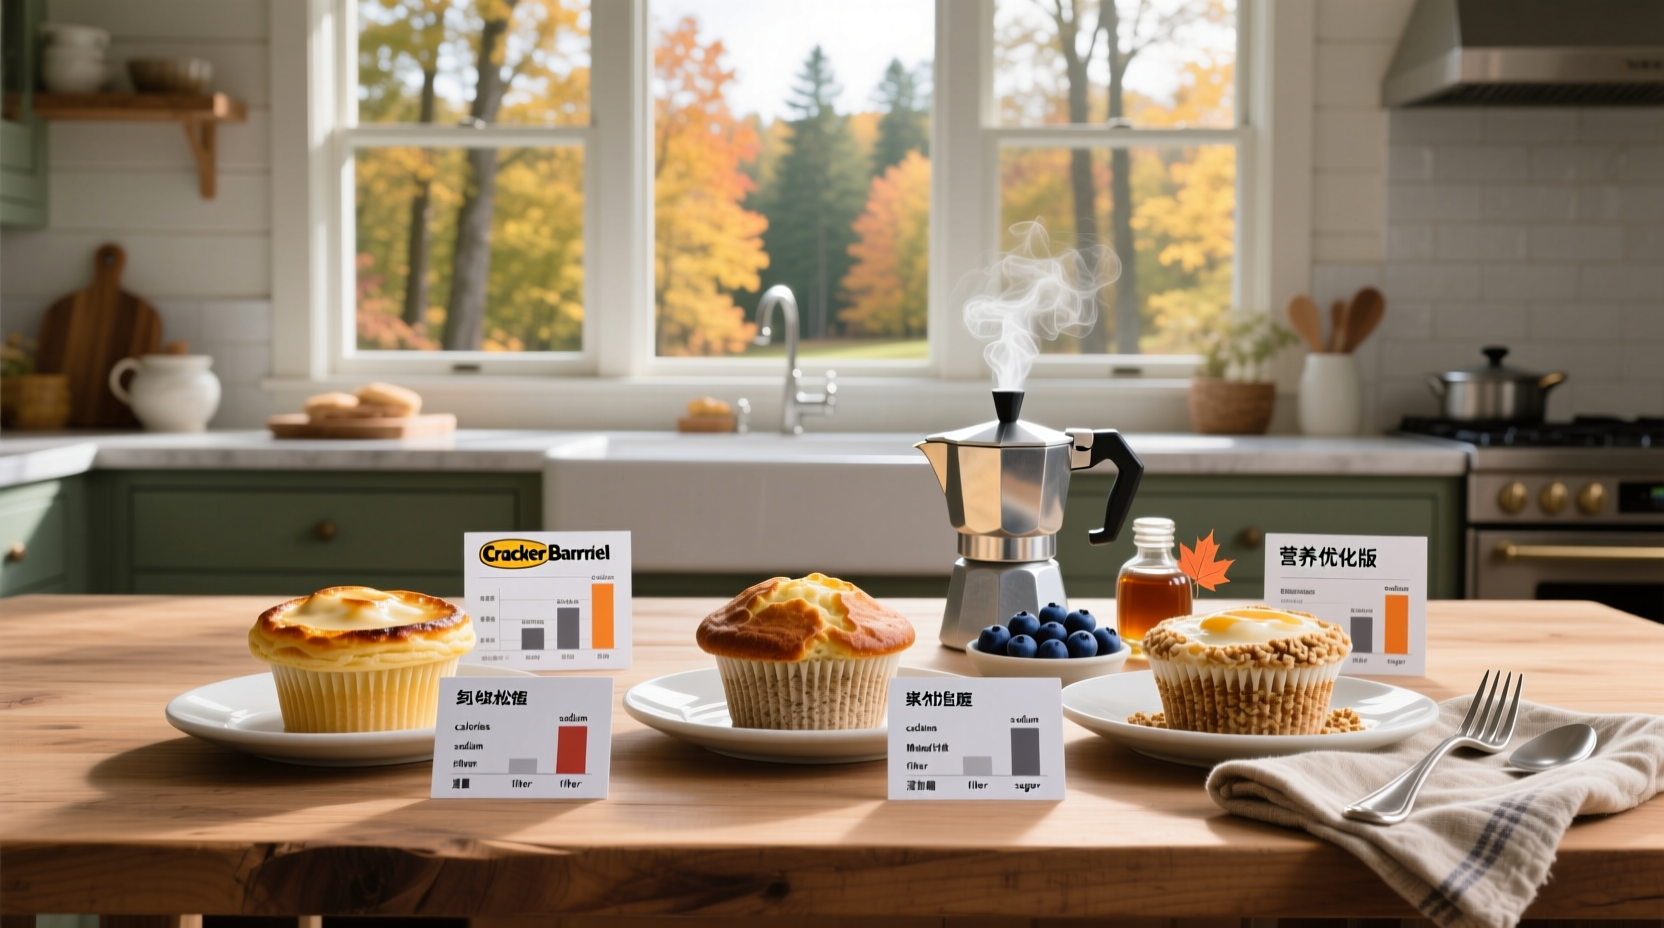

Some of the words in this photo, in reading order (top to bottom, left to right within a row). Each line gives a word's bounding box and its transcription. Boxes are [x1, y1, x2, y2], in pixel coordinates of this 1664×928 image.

[482, 544, 547, 562] Cracker
[1279, 545, 1377, 568] 营养优化版
